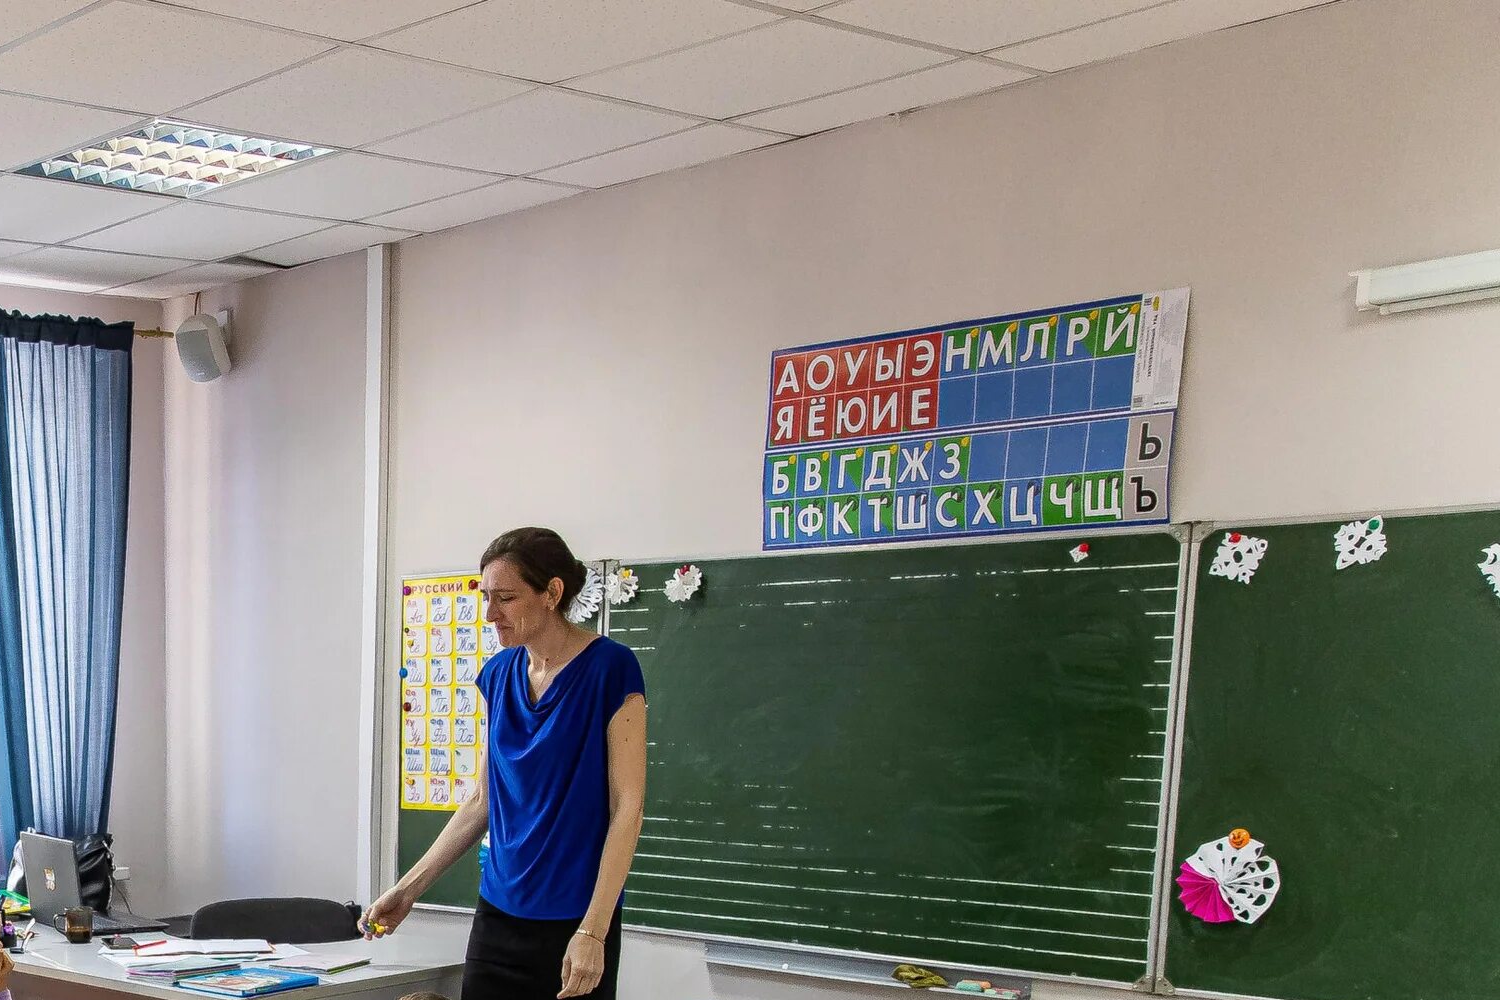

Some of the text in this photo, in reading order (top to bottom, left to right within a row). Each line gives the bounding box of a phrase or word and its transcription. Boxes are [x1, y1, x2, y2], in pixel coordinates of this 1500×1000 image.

[775, 360, 800, 396] А
[806, 354, 835, 391] О
[844, 349, 868, 386] У
[875, 343, 904, 382] Ы
[911, 339, 935, 377] Э
[945, 334, 971, 373] Н
[978, 330, 1013, 368] М
[1020, 322, 1051, 362] Л
[1066, 317, 1090, 356] Р
[1103, 307, 1136, 352] Й
[774, 388, 931, 441] Я Ё Ю И Е
[772, 422, 1163, 495] Б В Г Д Ж З Ь
[770, 475, 1158, 540] П Ф К Т Ш С Х Ц Ч Щ Ъ
